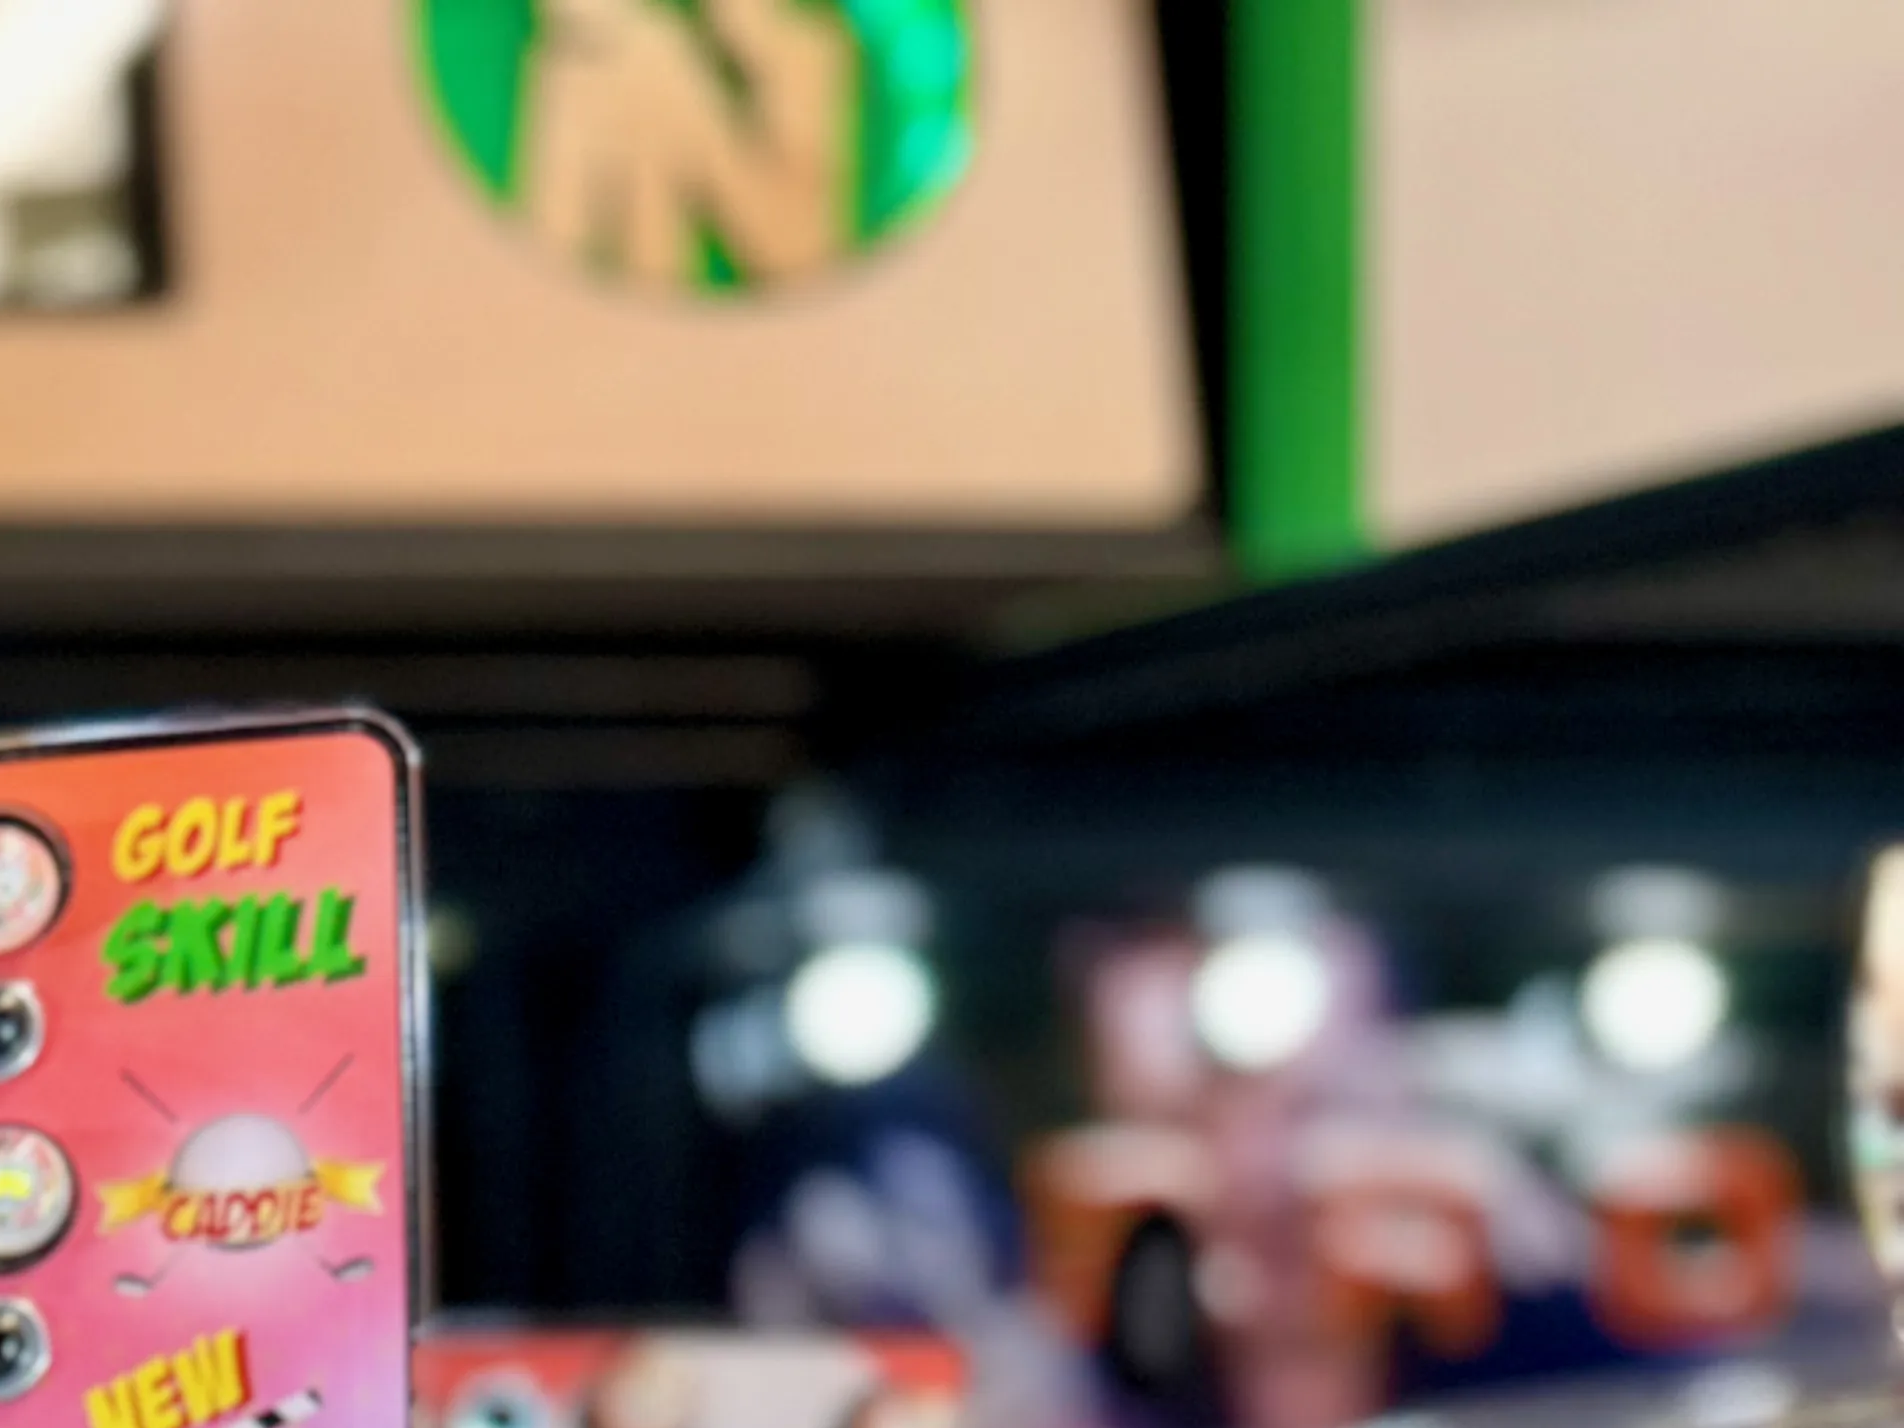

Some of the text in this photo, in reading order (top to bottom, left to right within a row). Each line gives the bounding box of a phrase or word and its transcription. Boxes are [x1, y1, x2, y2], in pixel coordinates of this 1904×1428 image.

[112, 790, 306, 884] GOLF
[100, 888, 368, 1005] SKILL
[159, 1181, 325, 1246] CADDIE
